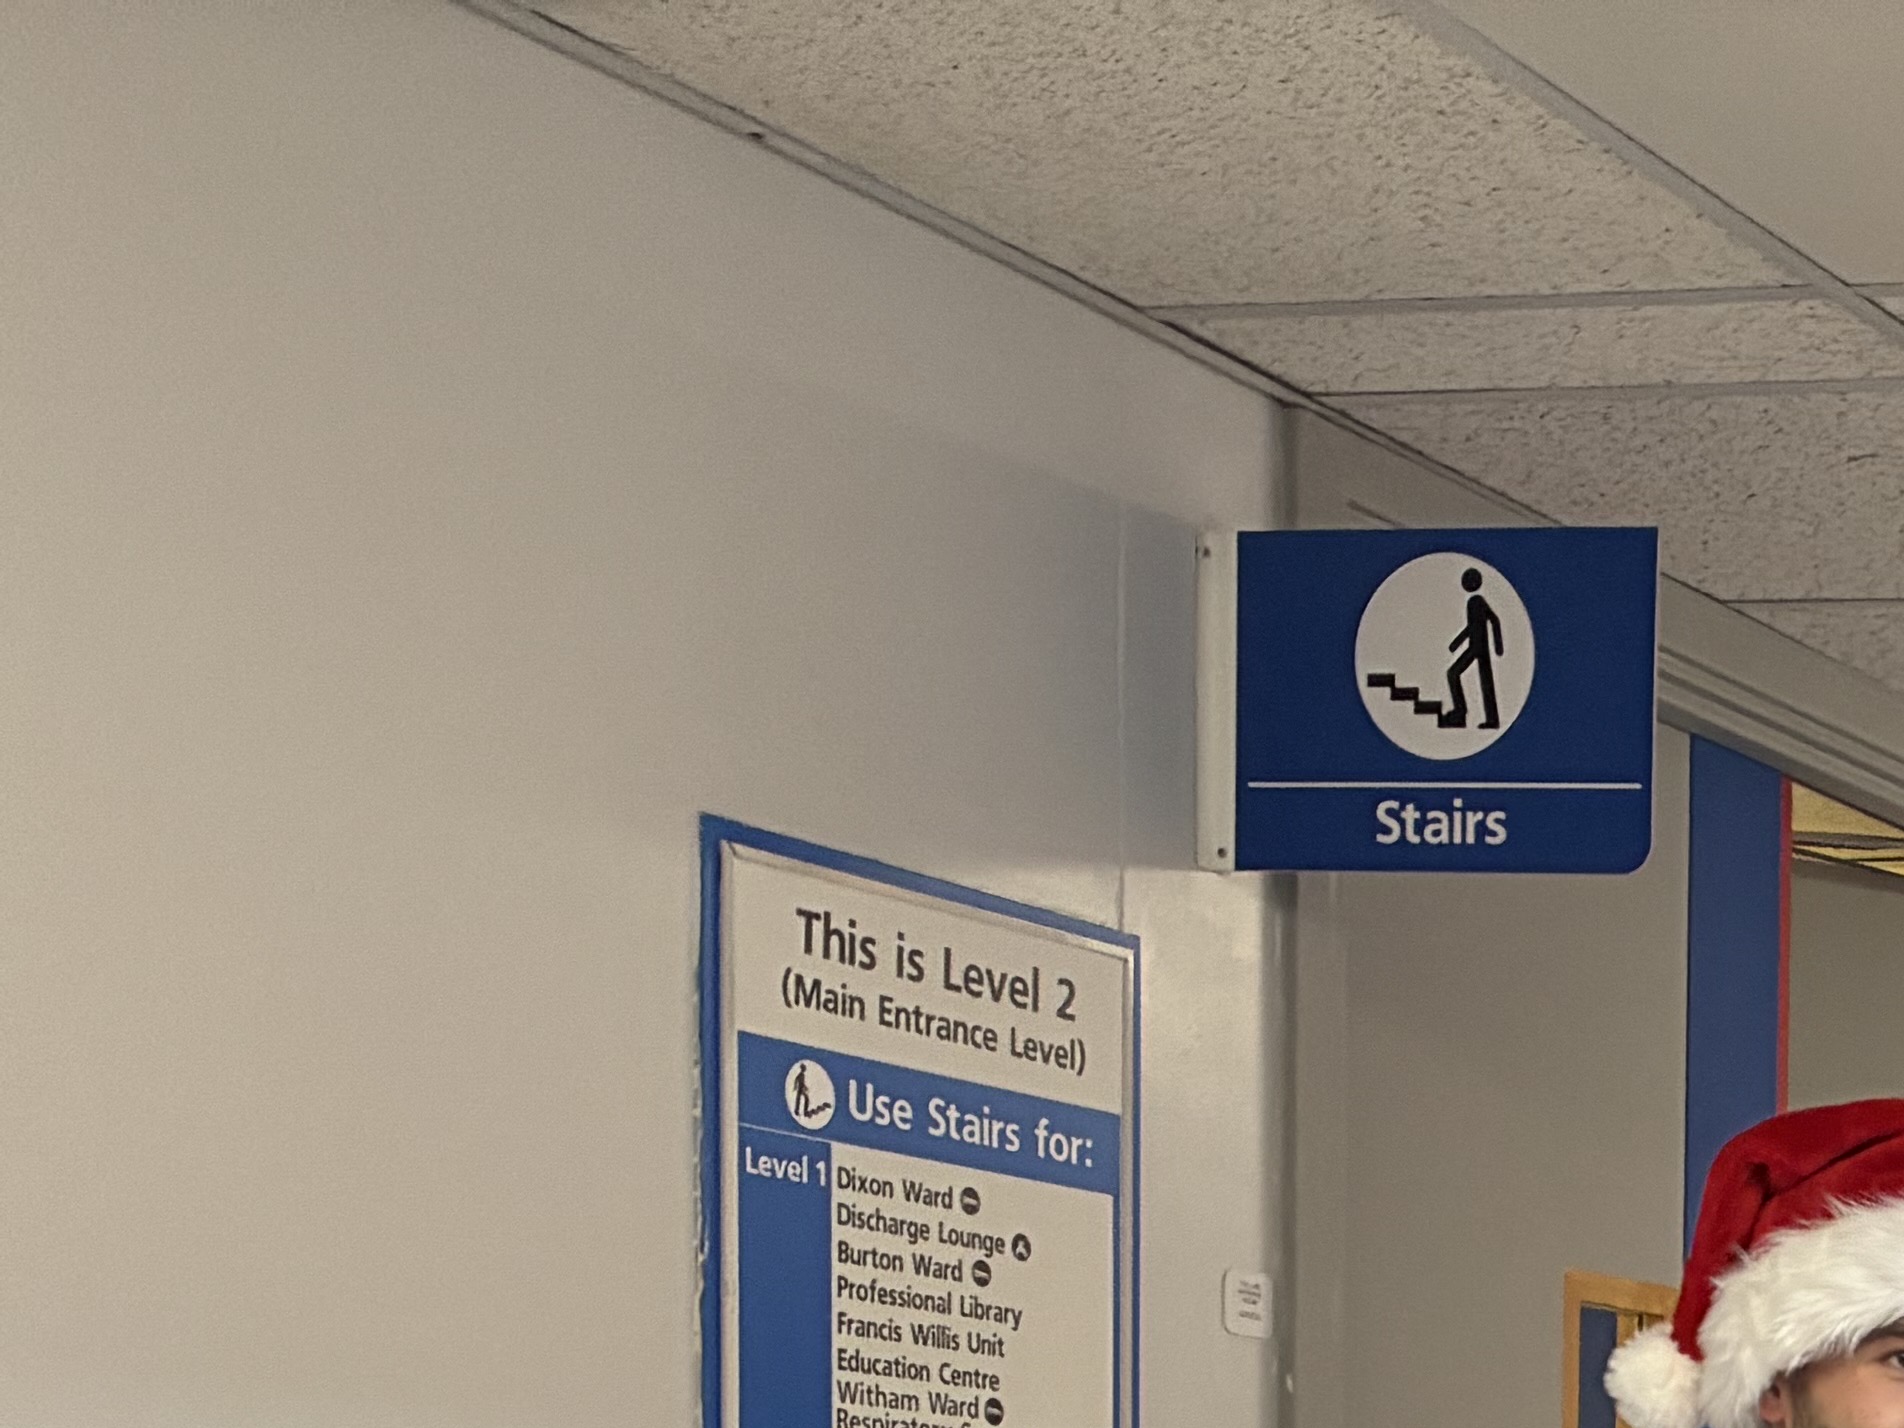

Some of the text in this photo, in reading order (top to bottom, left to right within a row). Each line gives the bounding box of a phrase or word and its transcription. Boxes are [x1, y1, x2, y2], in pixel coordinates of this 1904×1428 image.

[1376, 798, 1507, 845] Stairs
[796, 907, 1077, 1022] This is Level 2
[781, 967, 1086, 1077] (Main Entrance Level)
[848, 1079, 1094, 1168] Use Stairs for:
[745, 1147, 827, 1187] Level 1
[836, 1166, 953, 1210] Dixon Ward
[836, 1202, 1006, 1259] Discharge Lounge
[837, 1240, 963, 1284] Burton Ward
[836, 1275, 1023, 1331] Professional Library
[836, 1312, 1006, 1359] Francis Willis Unit
[837, 1348, 1001, 1392] Education Centre
[836, 1380, 980, 1420] Witham Ward
